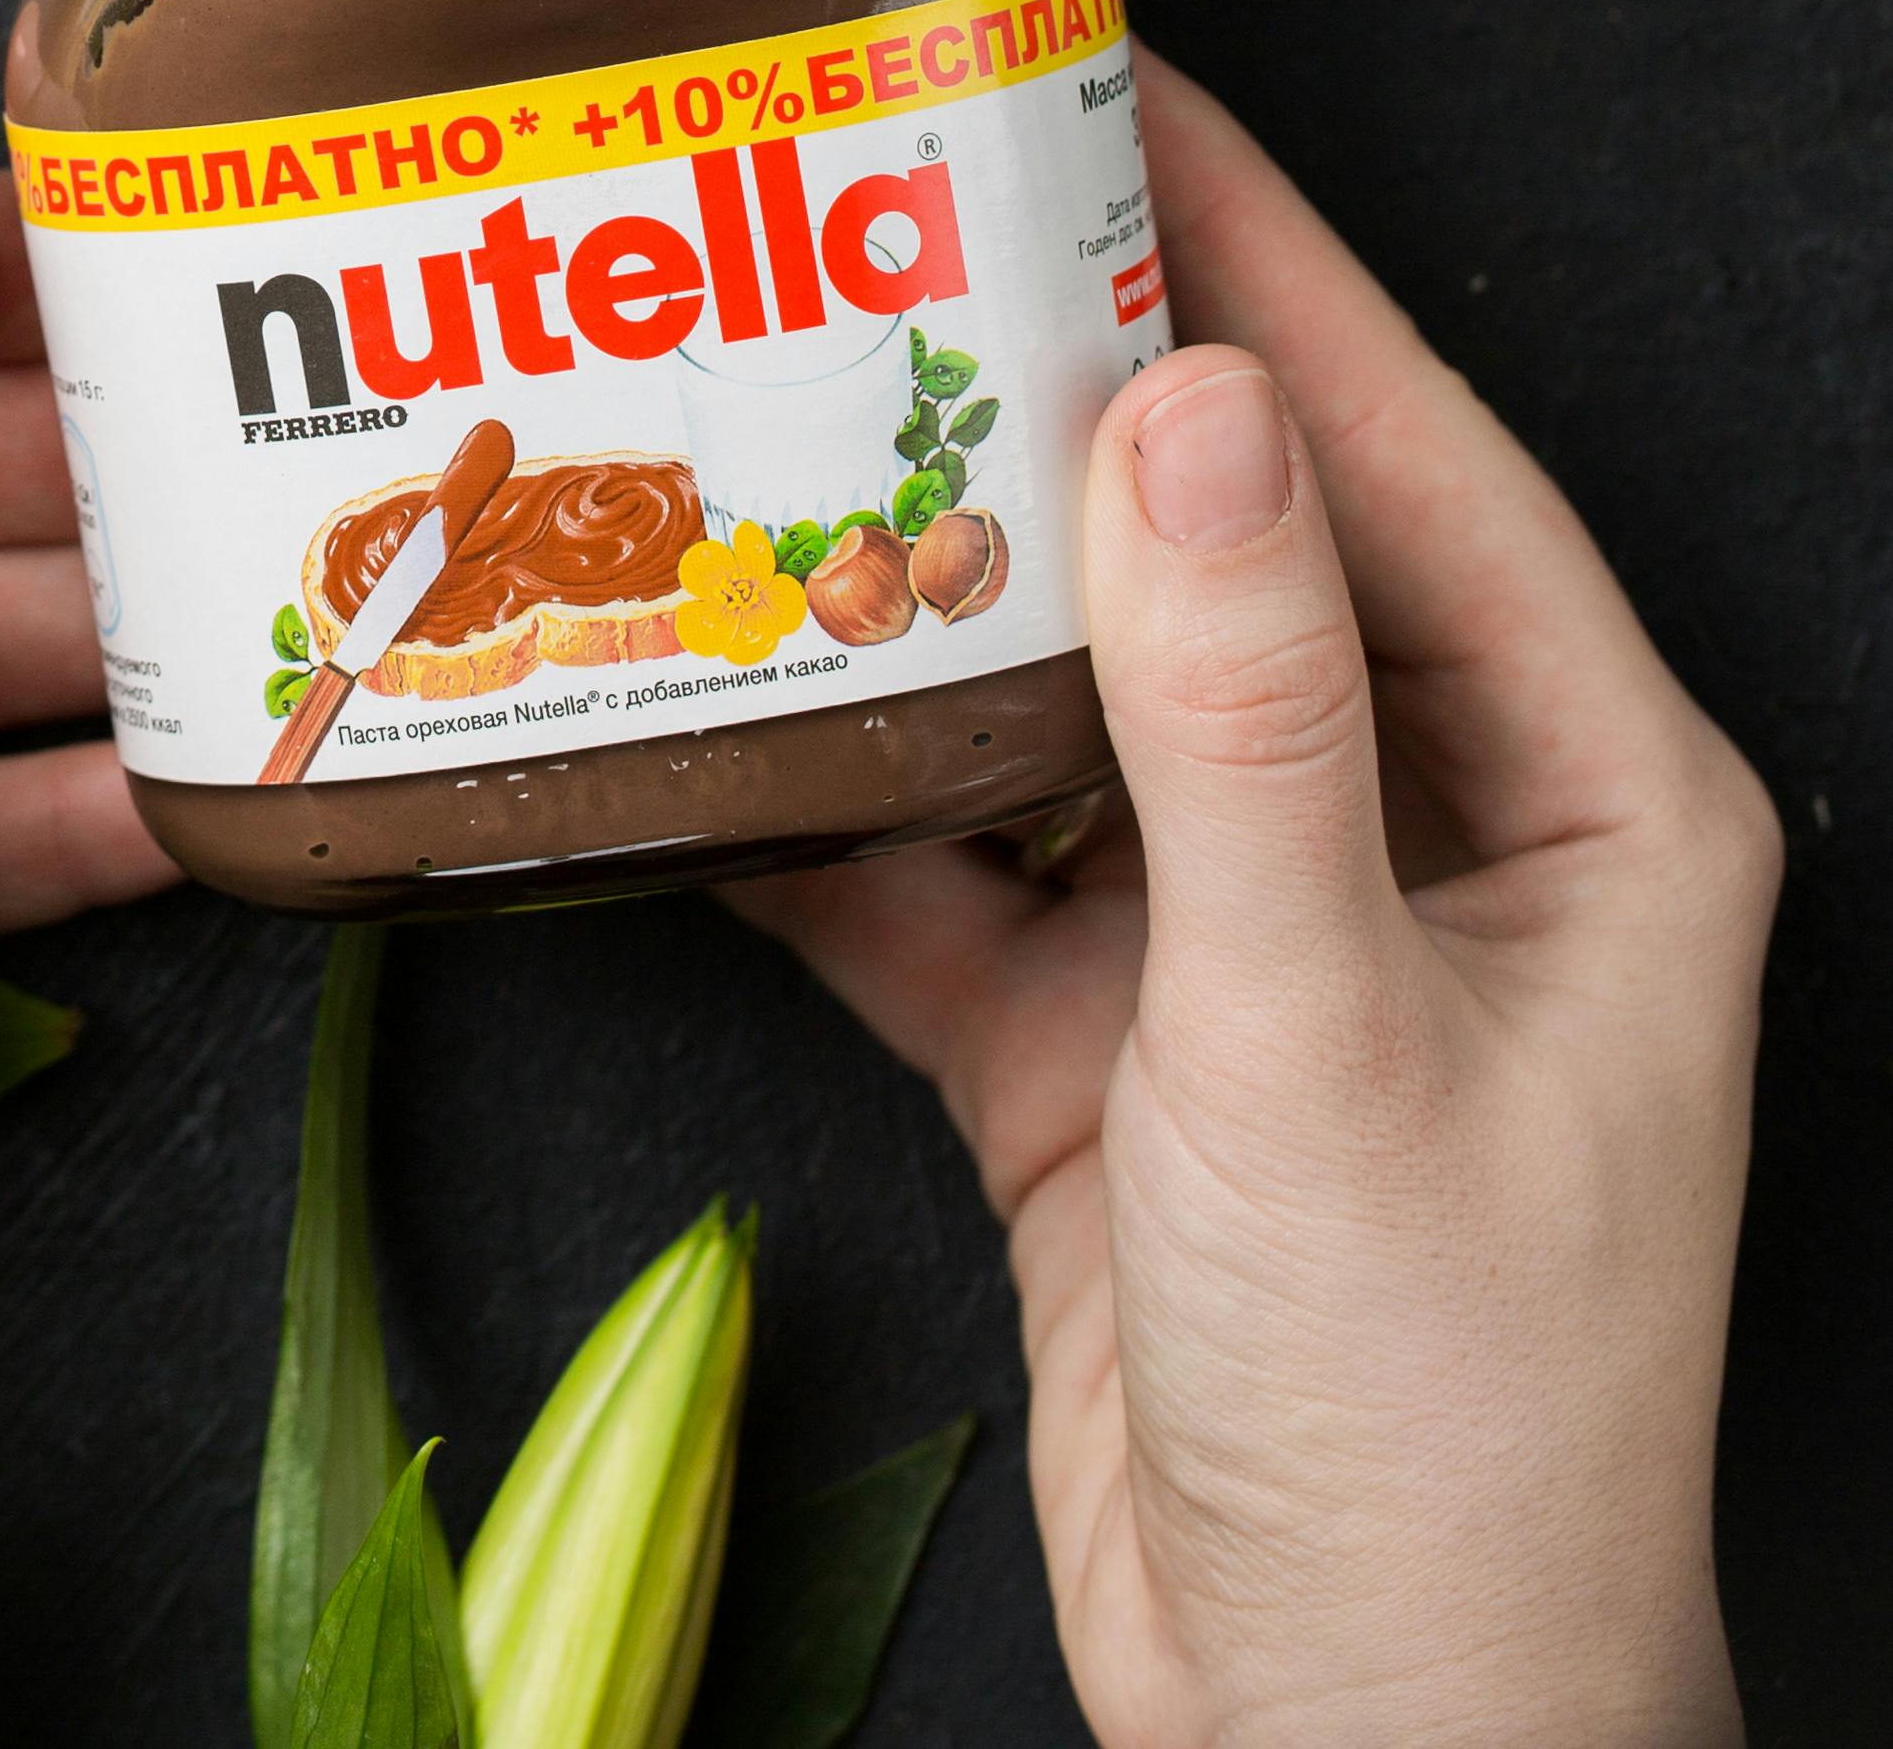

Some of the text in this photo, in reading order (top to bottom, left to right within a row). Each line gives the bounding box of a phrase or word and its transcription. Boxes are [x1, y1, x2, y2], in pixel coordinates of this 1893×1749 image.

[1079, 68, 1128, 114] Масса
[1078, 232, 1117, 261] Годен
[216, 135, 970, 416] nutella
[241, 404, 409, 445] FERRERO
[338, 724, 400, 746] Паста
[406, 710, 508, 742] ореховая
[606, 693, 618, 709] с
[625, 665, 778, 710] добавлением
[784, 653, 848, 679] какао
